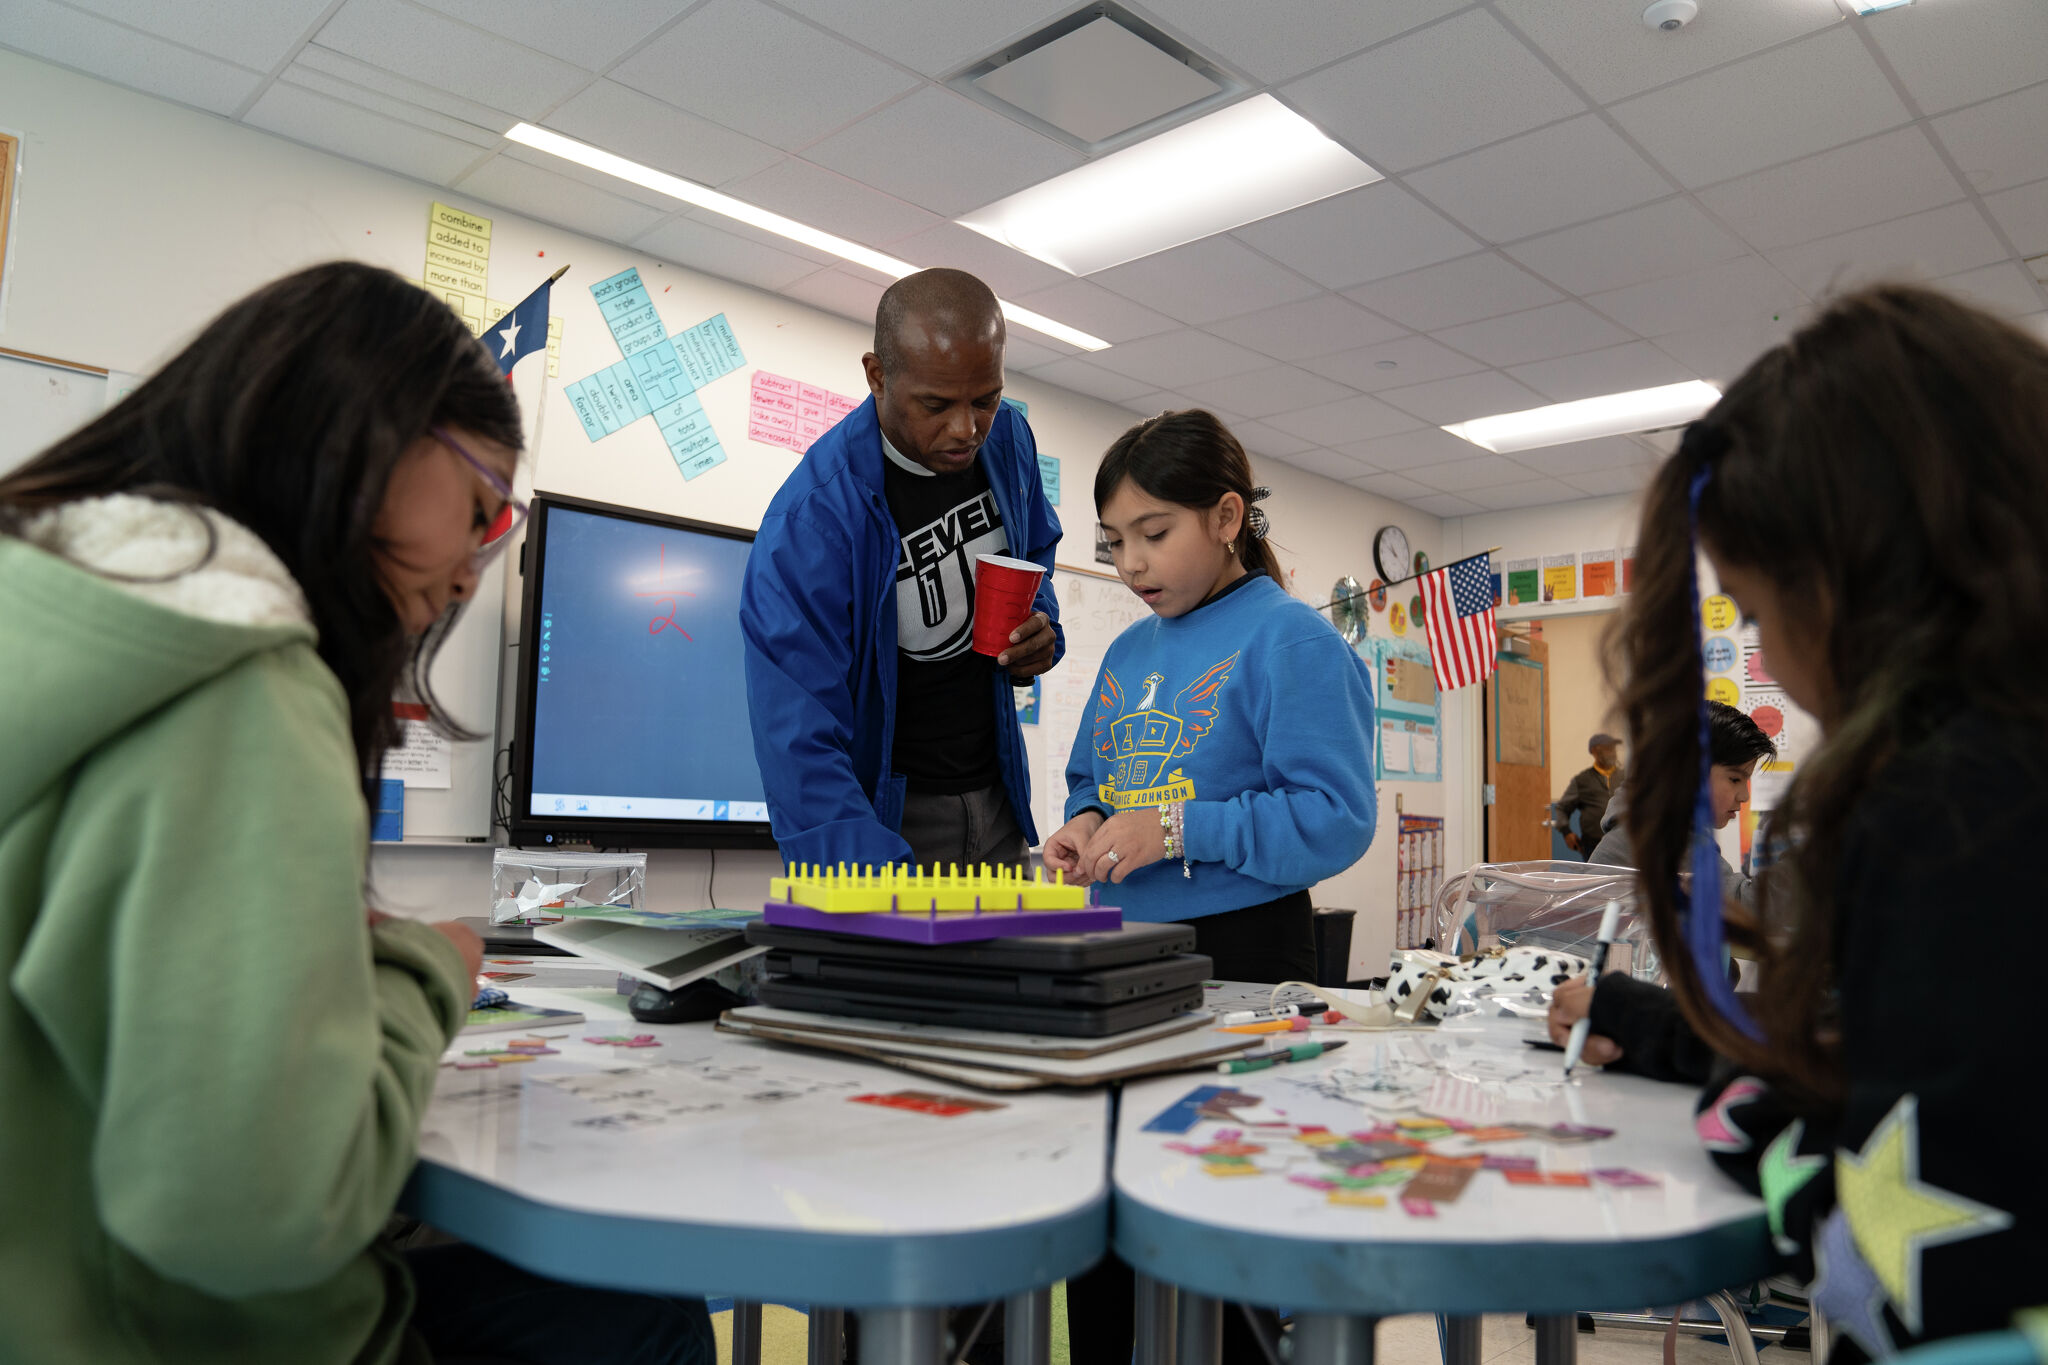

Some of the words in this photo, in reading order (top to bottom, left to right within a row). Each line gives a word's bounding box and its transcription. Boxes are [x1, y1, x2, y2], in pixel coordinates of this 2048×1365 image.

[440, 212, 483, 232] combine
[436, 232, 470, 249] added
[472, 242, 484, 253] to
[429, 251, 472, 269] increased
[474, 260, 485, 274] by
[430, 272, 457, 285] more
[461, 276, 482, 291] than
[595, 283, 614, 298] each
[615, 274, 640, 291] group
[614, 315, 643, 336] product
[645, 307, 655, 320] of
[624, 334, 652, 354] groups
[653, 325, 663, 338] of
[676, 344, 700, 380] product
[624, 379, 638, 401] area
[760, 377, 791, 392] subtract
[608, 384, 623, 409] twice
[753, 391, 775, 405] fewer
[777, 399, 794, 410] than
[576, 396, 595, 427] factor
[674, 403, 683, 416] of
[678, 419, 696, 435] total
[752, 425, 791, 445] decreased
[1134, 786, 1188, 804] JOHNSON
